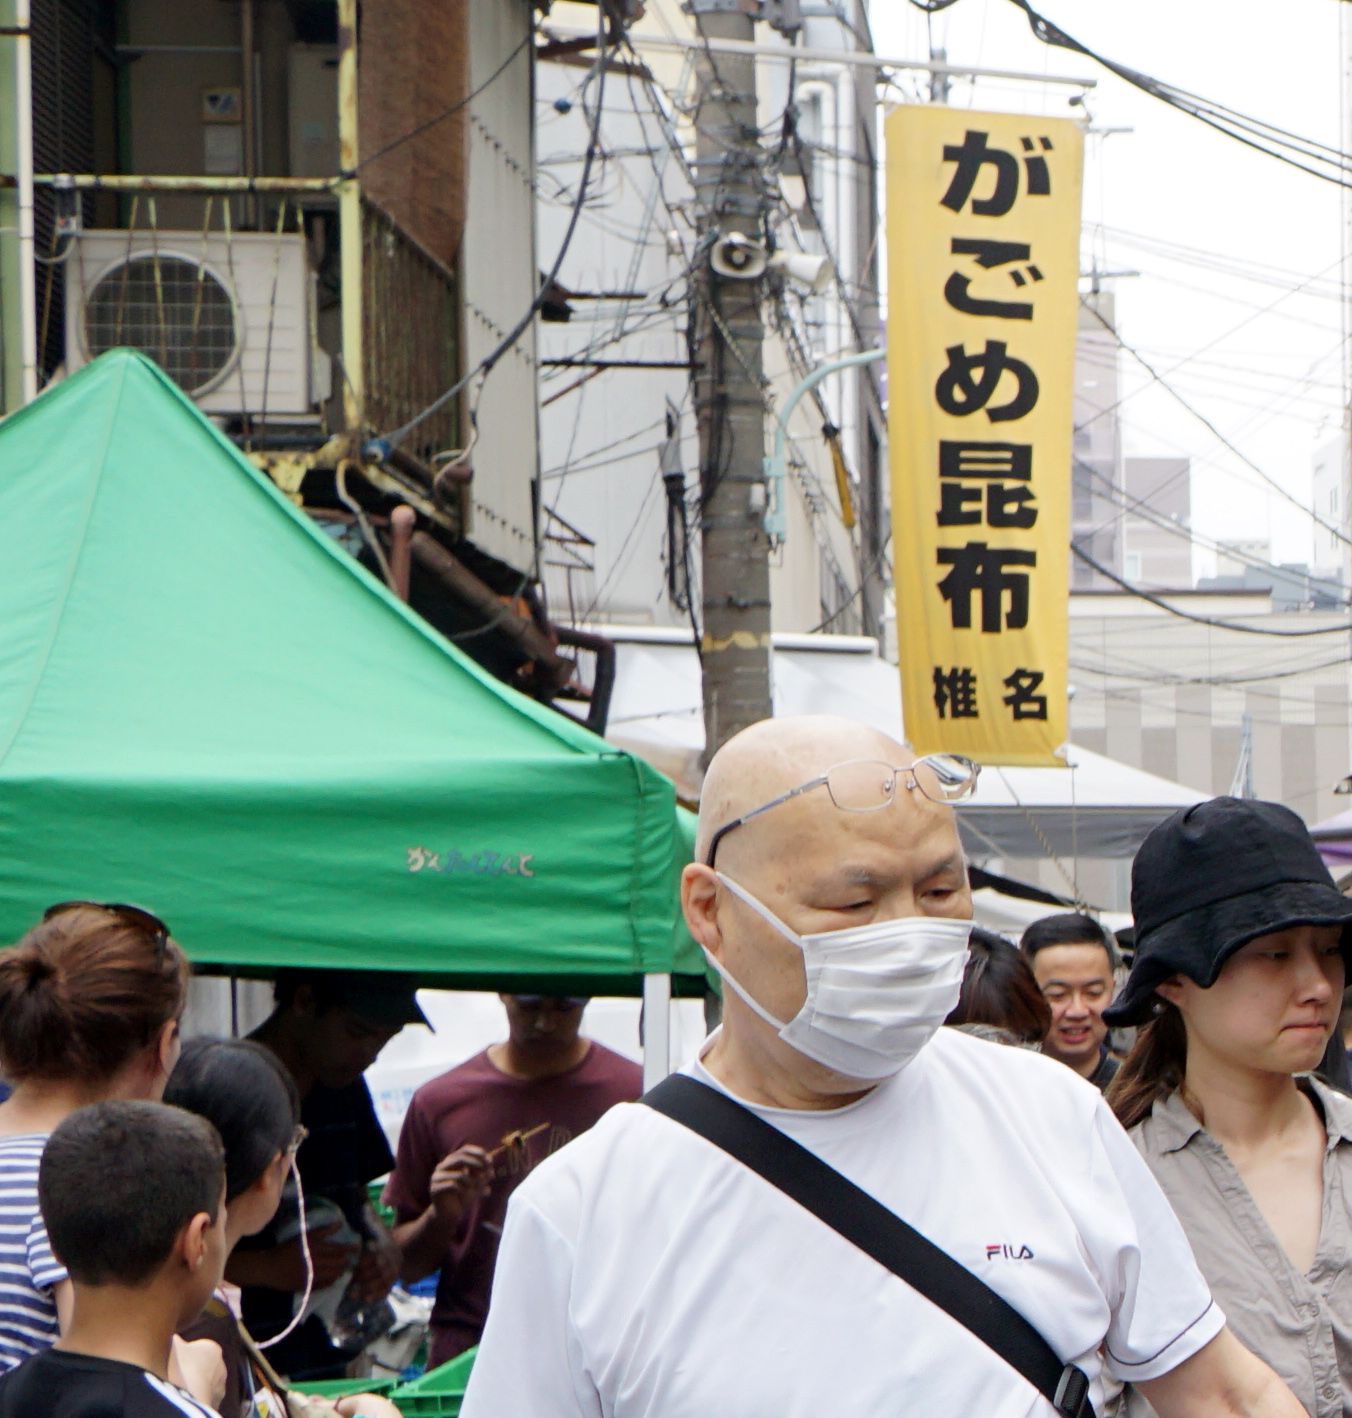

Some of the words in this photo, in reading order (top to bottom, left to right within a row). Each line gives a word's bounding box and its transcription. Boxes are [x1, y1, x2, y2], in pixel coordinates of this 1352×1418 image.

[935, 129, 1053, 635] がごめ昆布
[932, 665, 1049, 721] 椎名
[985, 1243, 1034, 1261] FILA
